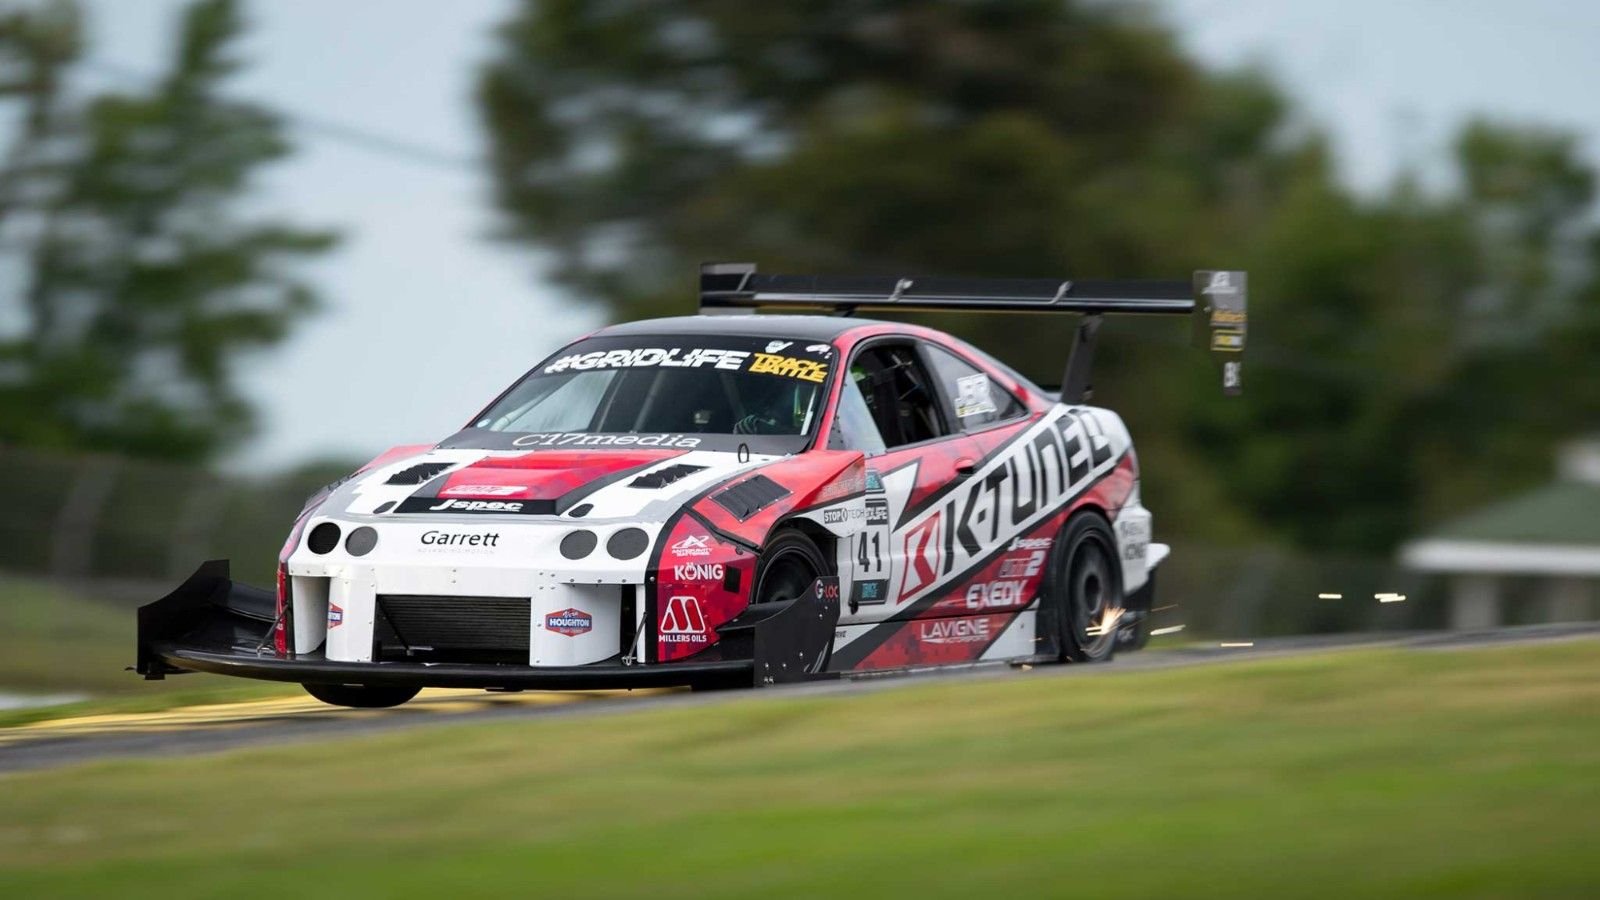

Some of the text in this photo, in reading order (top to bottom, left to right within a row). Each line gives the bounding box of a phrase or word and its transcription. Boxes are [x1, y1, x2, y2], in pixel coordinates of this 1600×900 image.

[544, 348, 751, 374] #GRIDLIFE
[751, 353, 829, 371] TRACK
[748, 363, 828, 383] BATTLE
[512, 433, 702, 448] C17media
[429, 499, 524, 512] Jspec
[420, 530, 500, 547] Garrett
[858, 532, 881, 572] 41
[674, 562, 724, 580] KÖNIG
[815, 579, 838, 599] G-LOC
[966, 580, 1029, 610] EXEDY
[550, 618, 589, 627] HOUGHTON
[920, 618, 989, 640] LAVIGNE
[658, 634, 707, 642] MILLERS OILS
